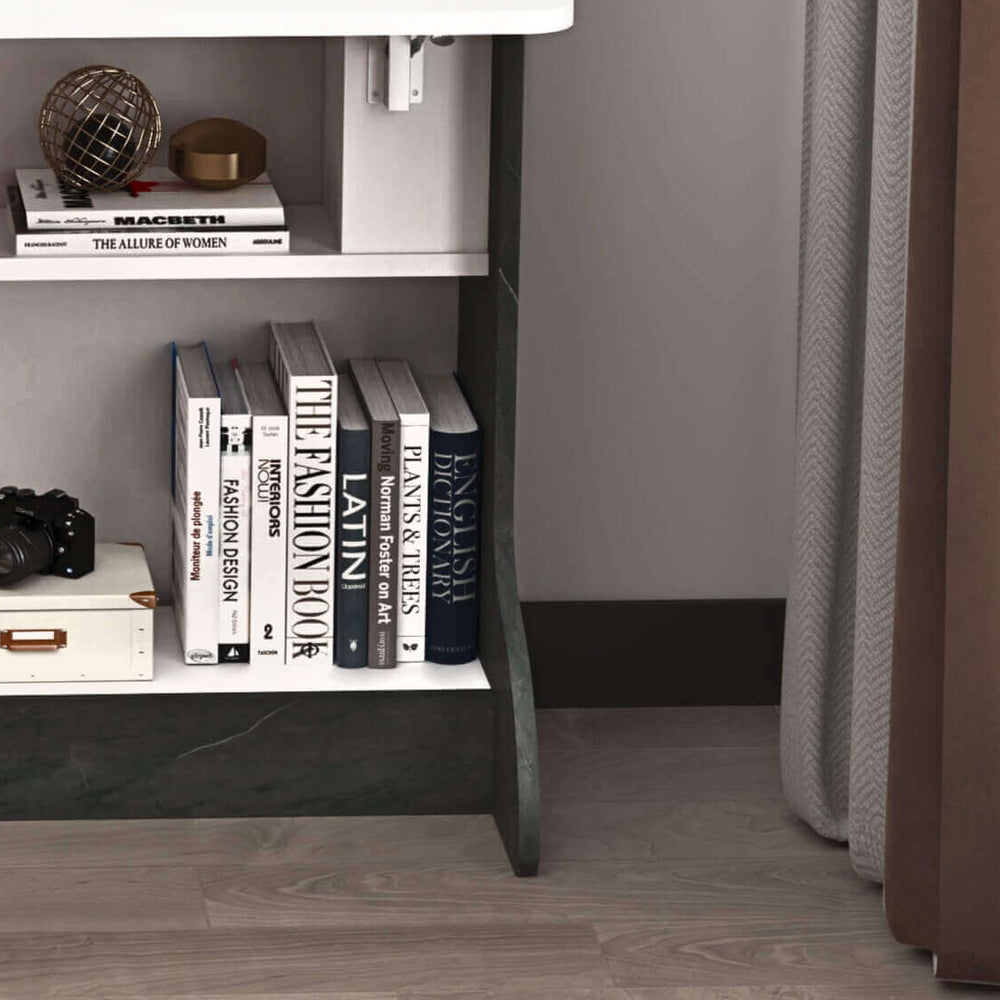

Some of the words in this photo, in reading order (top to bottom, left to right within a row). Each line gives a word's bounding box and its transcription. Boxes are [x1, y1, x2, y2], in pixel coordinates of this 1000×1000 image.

[92, 239, 117, 250] THE
[118, 238, 164, 250] ALLURE
[165, 238, 181, 249] OF
[182, 237, 227, 249] WOMEN
[114, 215, 226, 226] MACBETH
[295, 380, 333, 440] THE
[379, 422, 395, 473] Moving
[257, 459, 269, 503] NOW!
[269, 459, 281, 538] INTERIORS
[379, 476, 395, 531] Norman
[403, 445, 422, 524] PLANTS
[190, 490, 203, 527] plongée
[190, 528, 201, 540] de
[223, 479, 239, 542] FASHION
[293, 447, 332, 571] FASHION
[341, 474, 367, 581] LATIN
[432, 452, 453, 604] DICTIONARY
[451, 452, 478, 605] ENGLISH
[190, 541, 201, 581] Moniteur
[379, 535, 394, 579] Foster
[402, 528, 421, 546] &
[224, 548, 239, 602] DESIGN
[378, 582, 391, 600] on
[402, 549, 420, 616] TREES
[263, 624, 273, 640] 2
[292, 579, 329, 659] BOOK
[378, 602, 393, 624] Art
